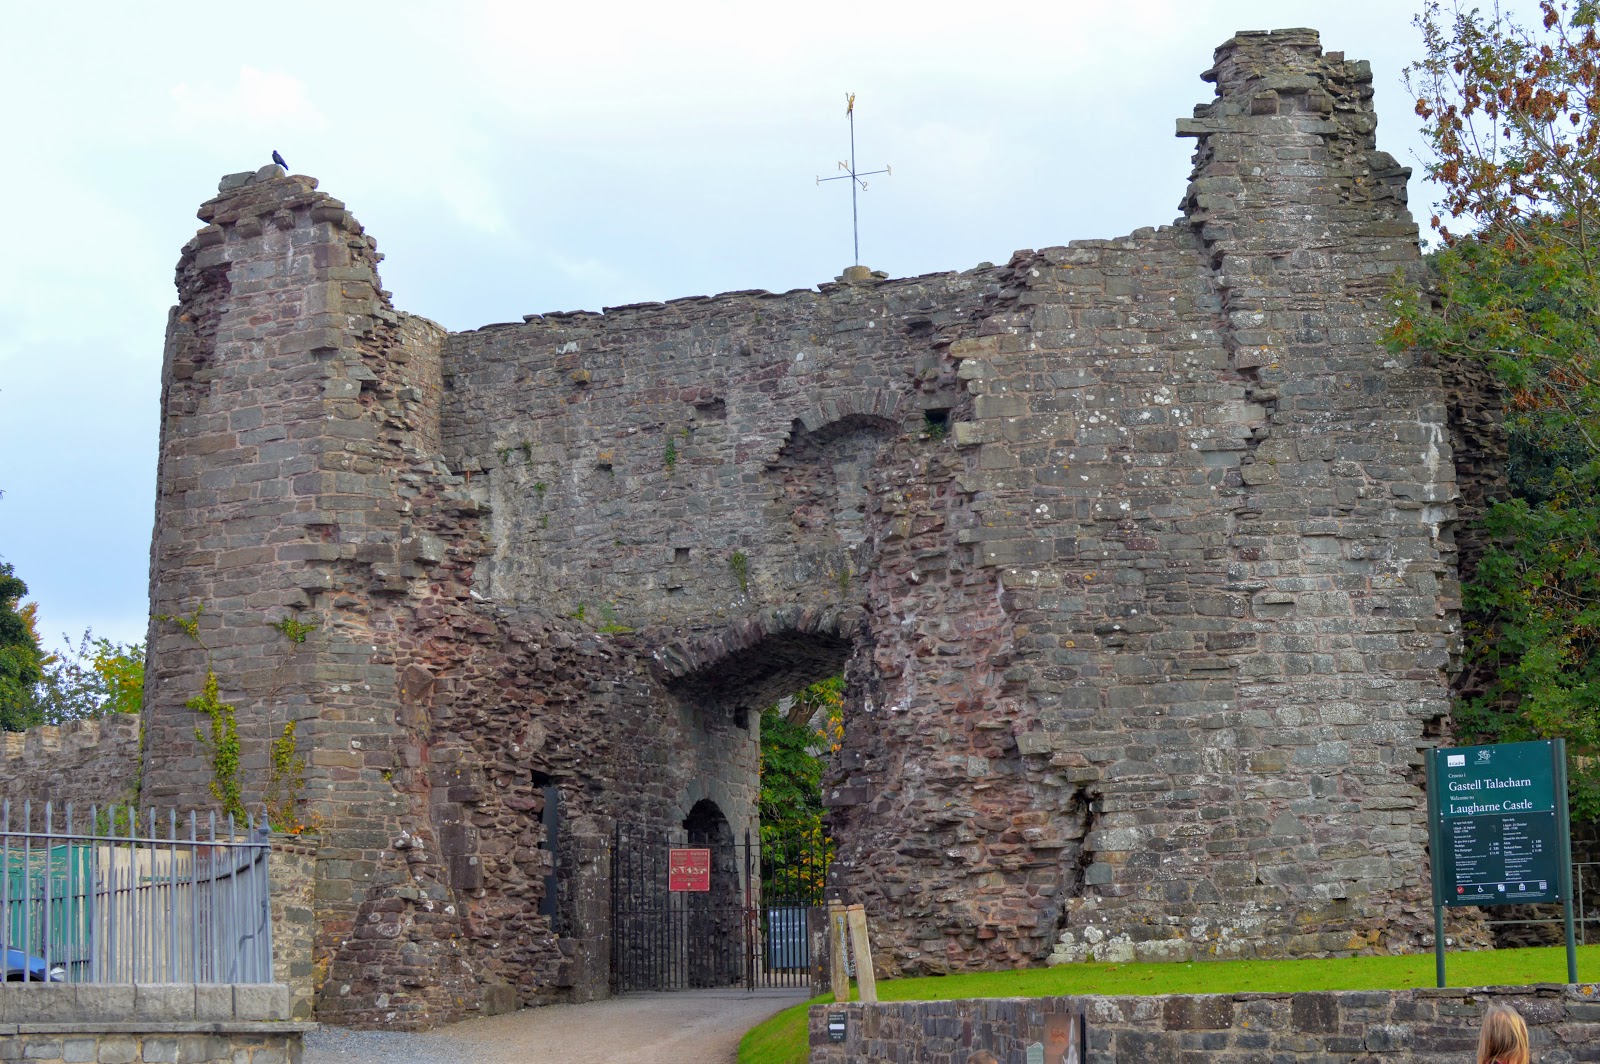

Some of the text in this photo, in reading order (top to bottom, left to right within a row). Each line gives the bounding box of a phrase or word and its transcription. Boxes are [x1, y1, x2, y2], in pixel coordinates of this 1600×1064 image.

[1448, 778, 1532, 792] Gastell Talacharn
[1450, 798, 1532, 815] Laugharne Castle
